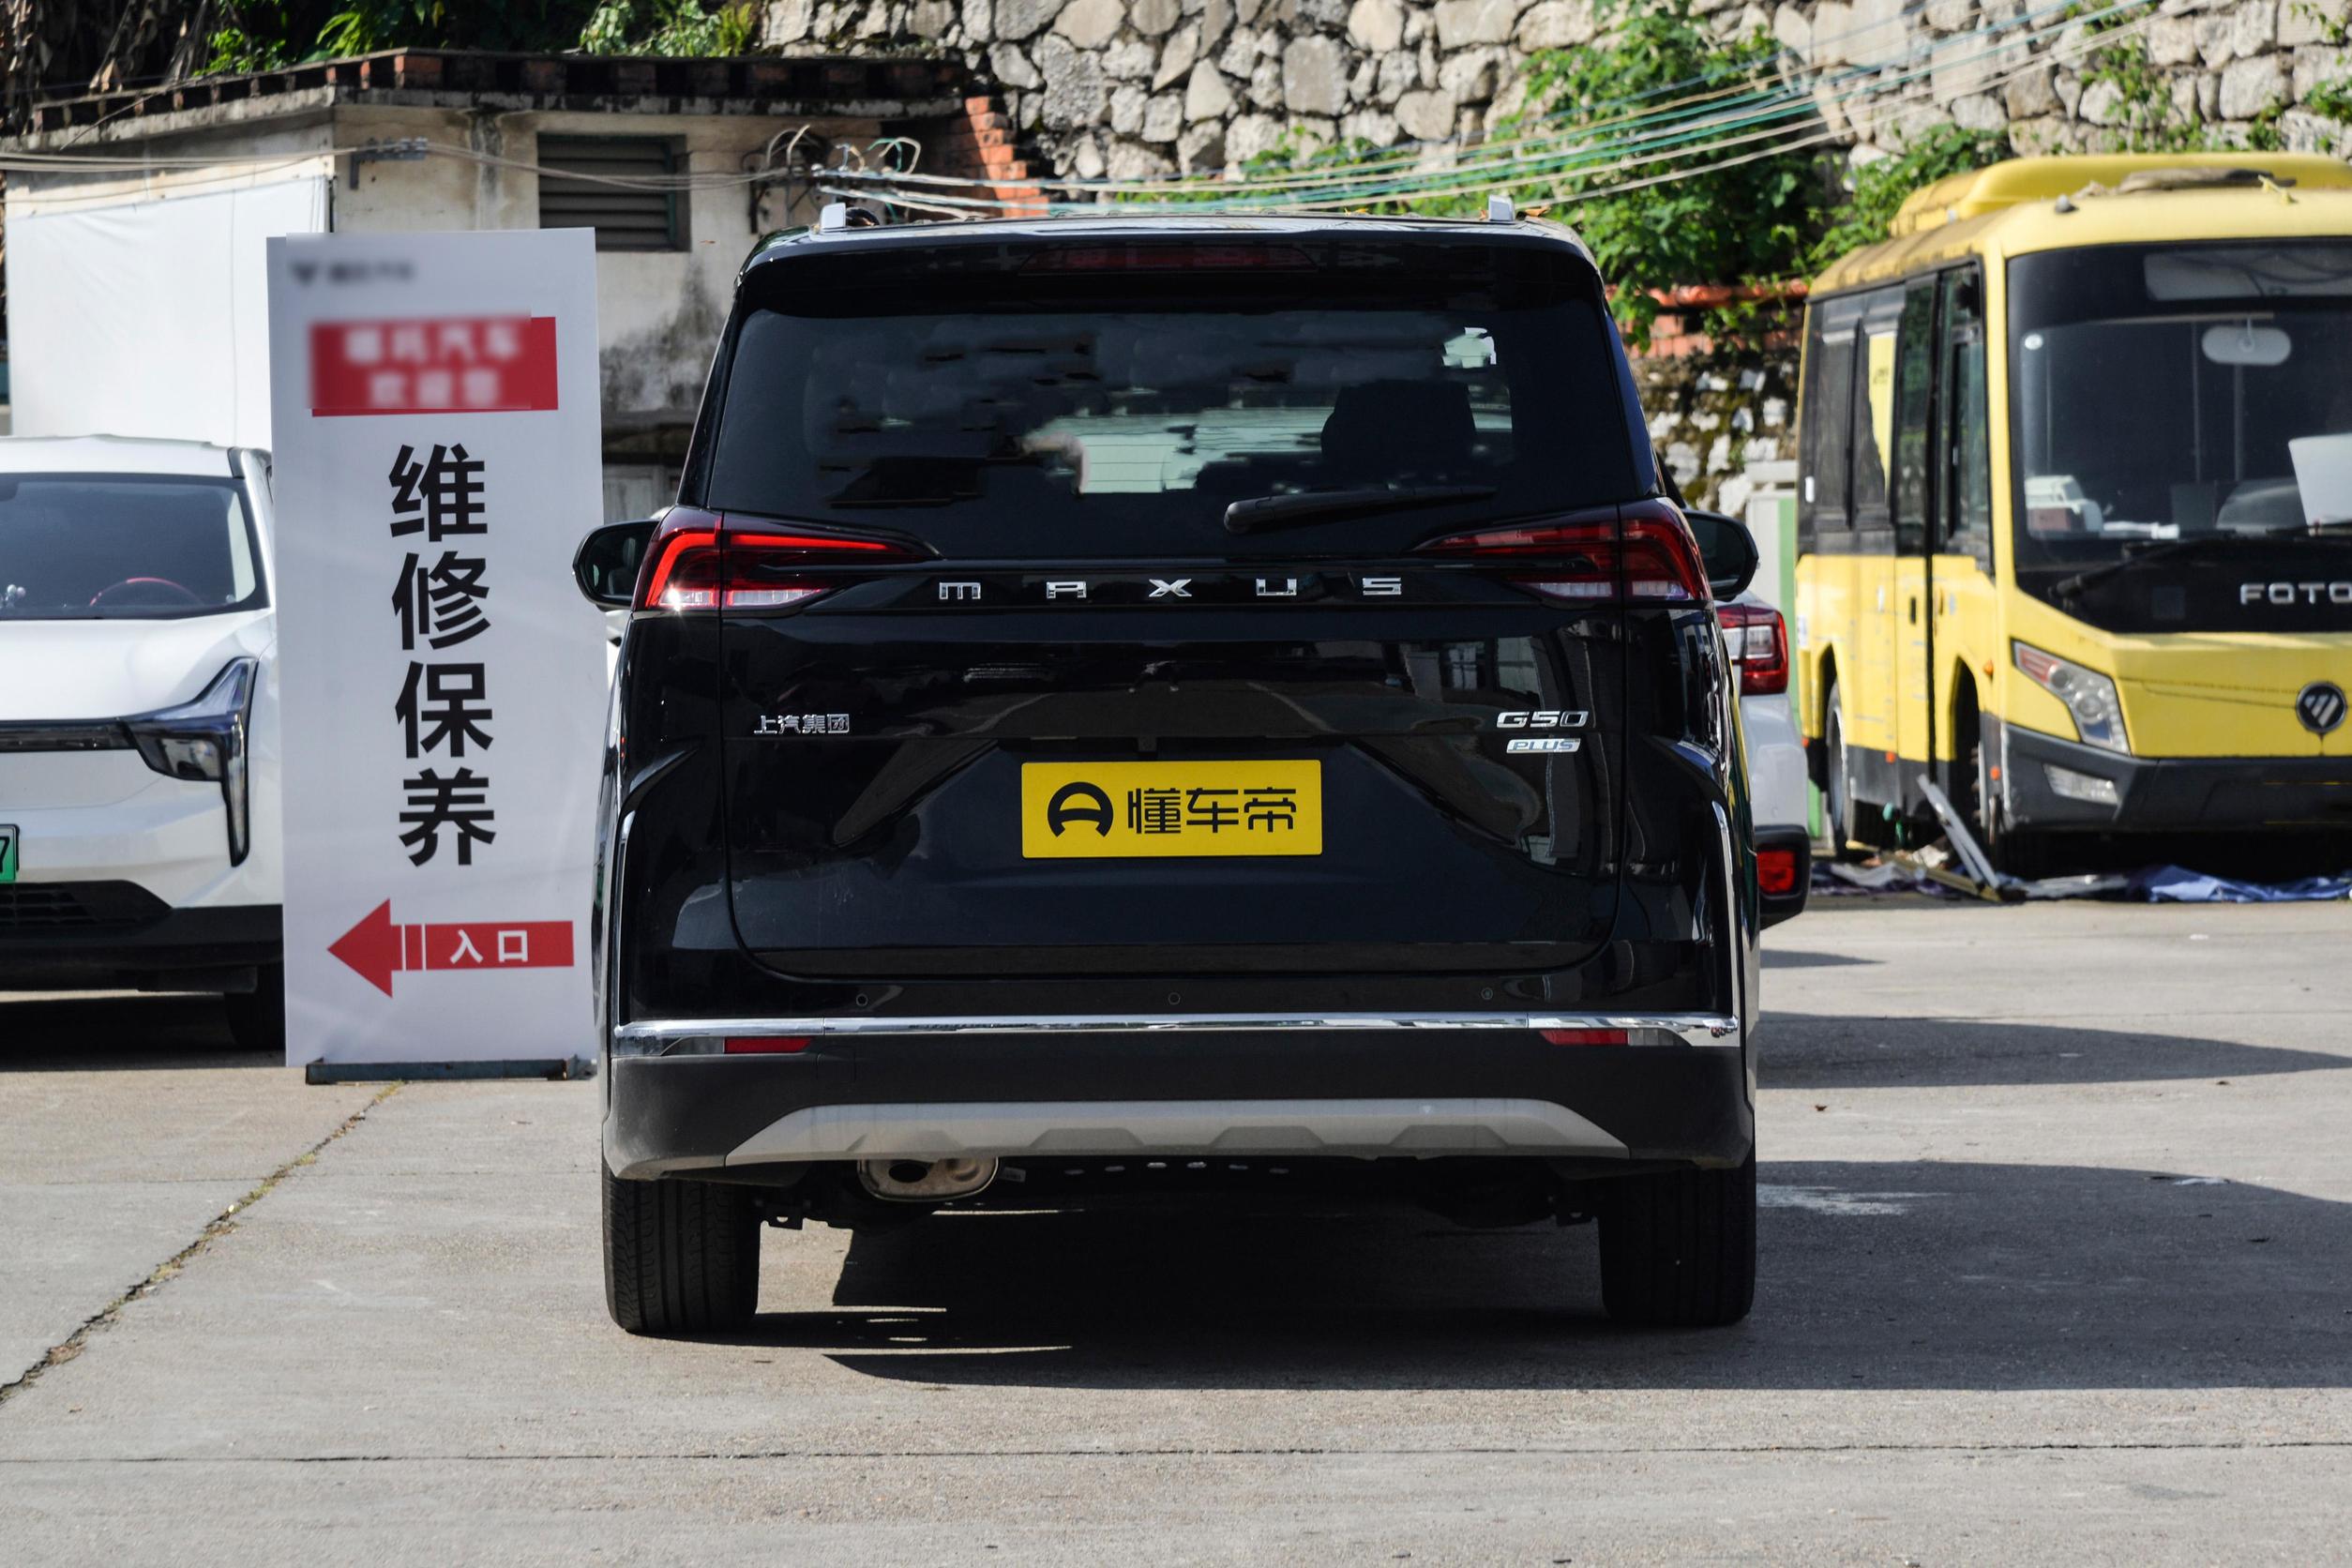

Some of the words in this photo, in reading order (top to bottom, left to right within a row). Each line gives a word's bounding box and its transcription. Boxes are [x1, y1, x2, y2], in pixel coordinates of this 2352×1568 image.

[936, 576, 1405, 600] MAXUS
[389, 444, 495, 867] 维修保养
[753, 713, 850, 734] 上汽集团
[1496, 710, 1590, 729] G50
[1510, 739, 1576, 752] PLUS
[1127, 786, 1297, 835] 懂车帝
[448, 928, 529, 965] 入口
